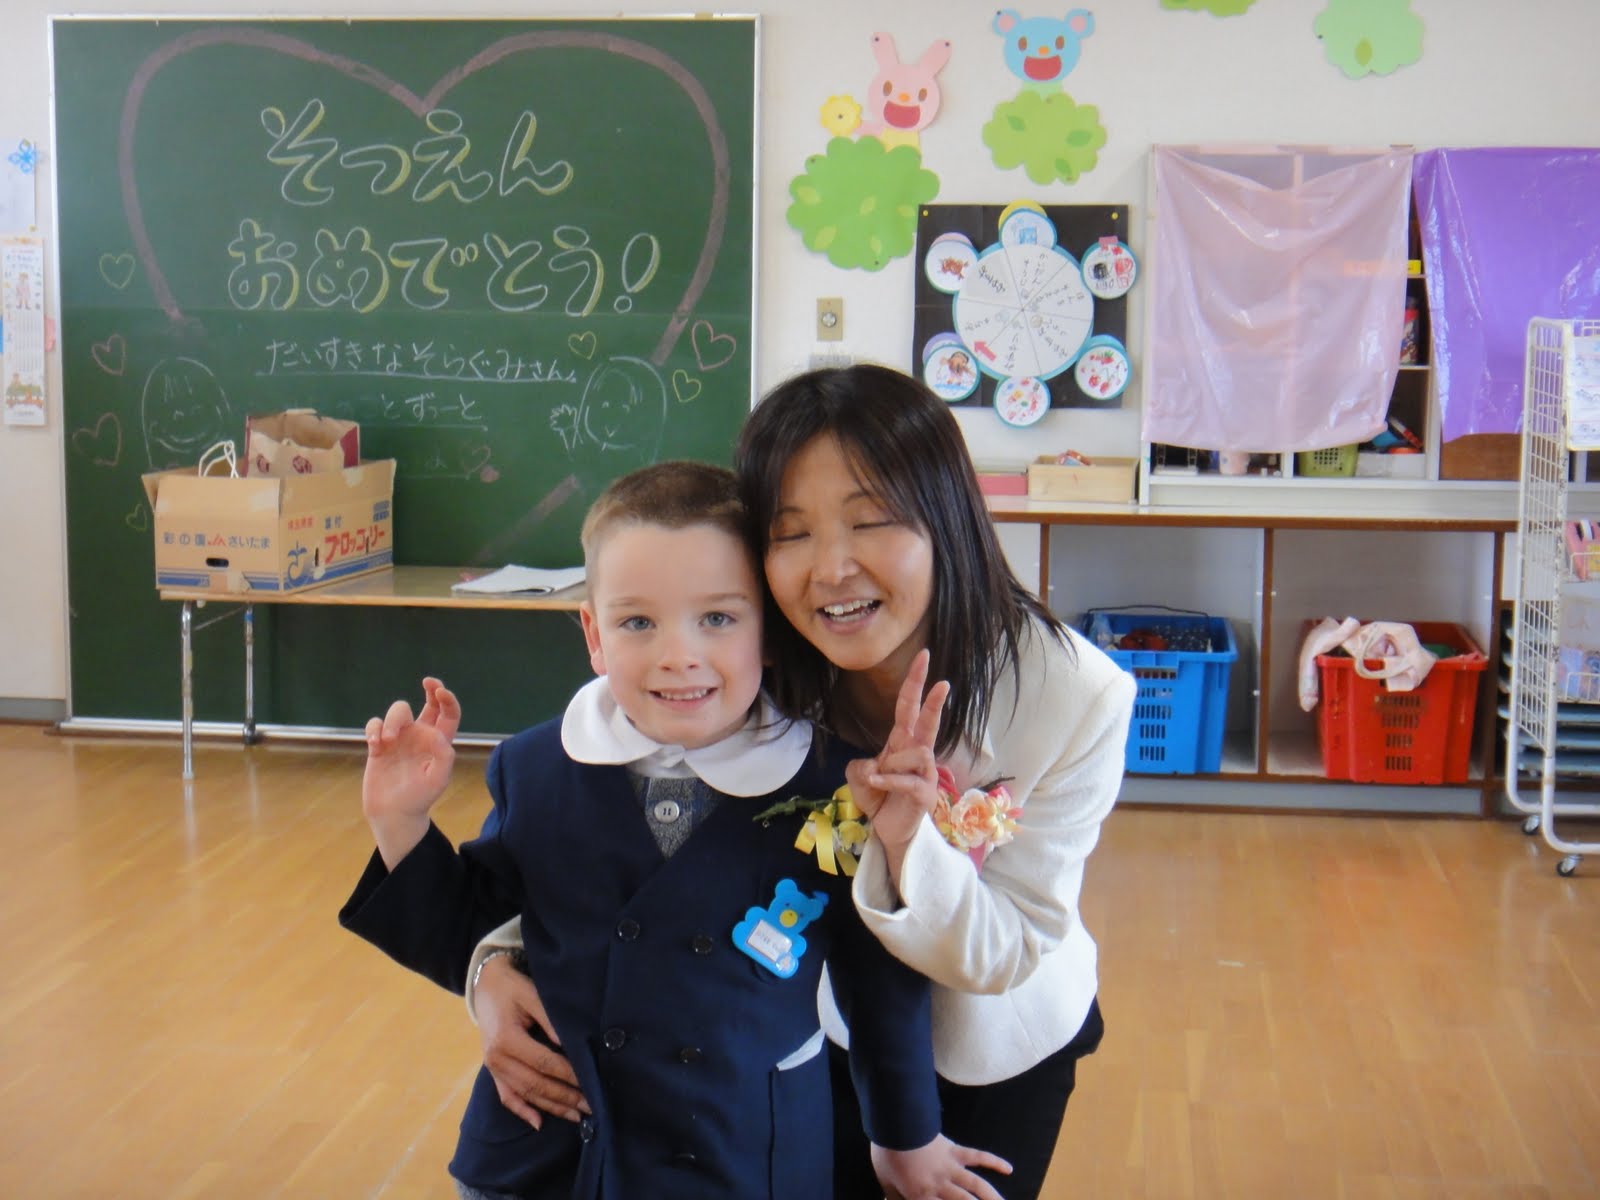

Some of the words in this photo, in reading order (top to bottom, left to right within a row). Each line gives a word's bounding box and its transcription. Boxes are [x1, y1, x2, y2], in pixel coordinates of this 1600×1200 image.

[227, 217, 661, 318] おめでとう!
[265, 336, 576, 382] だいすきなそらぐみさん
